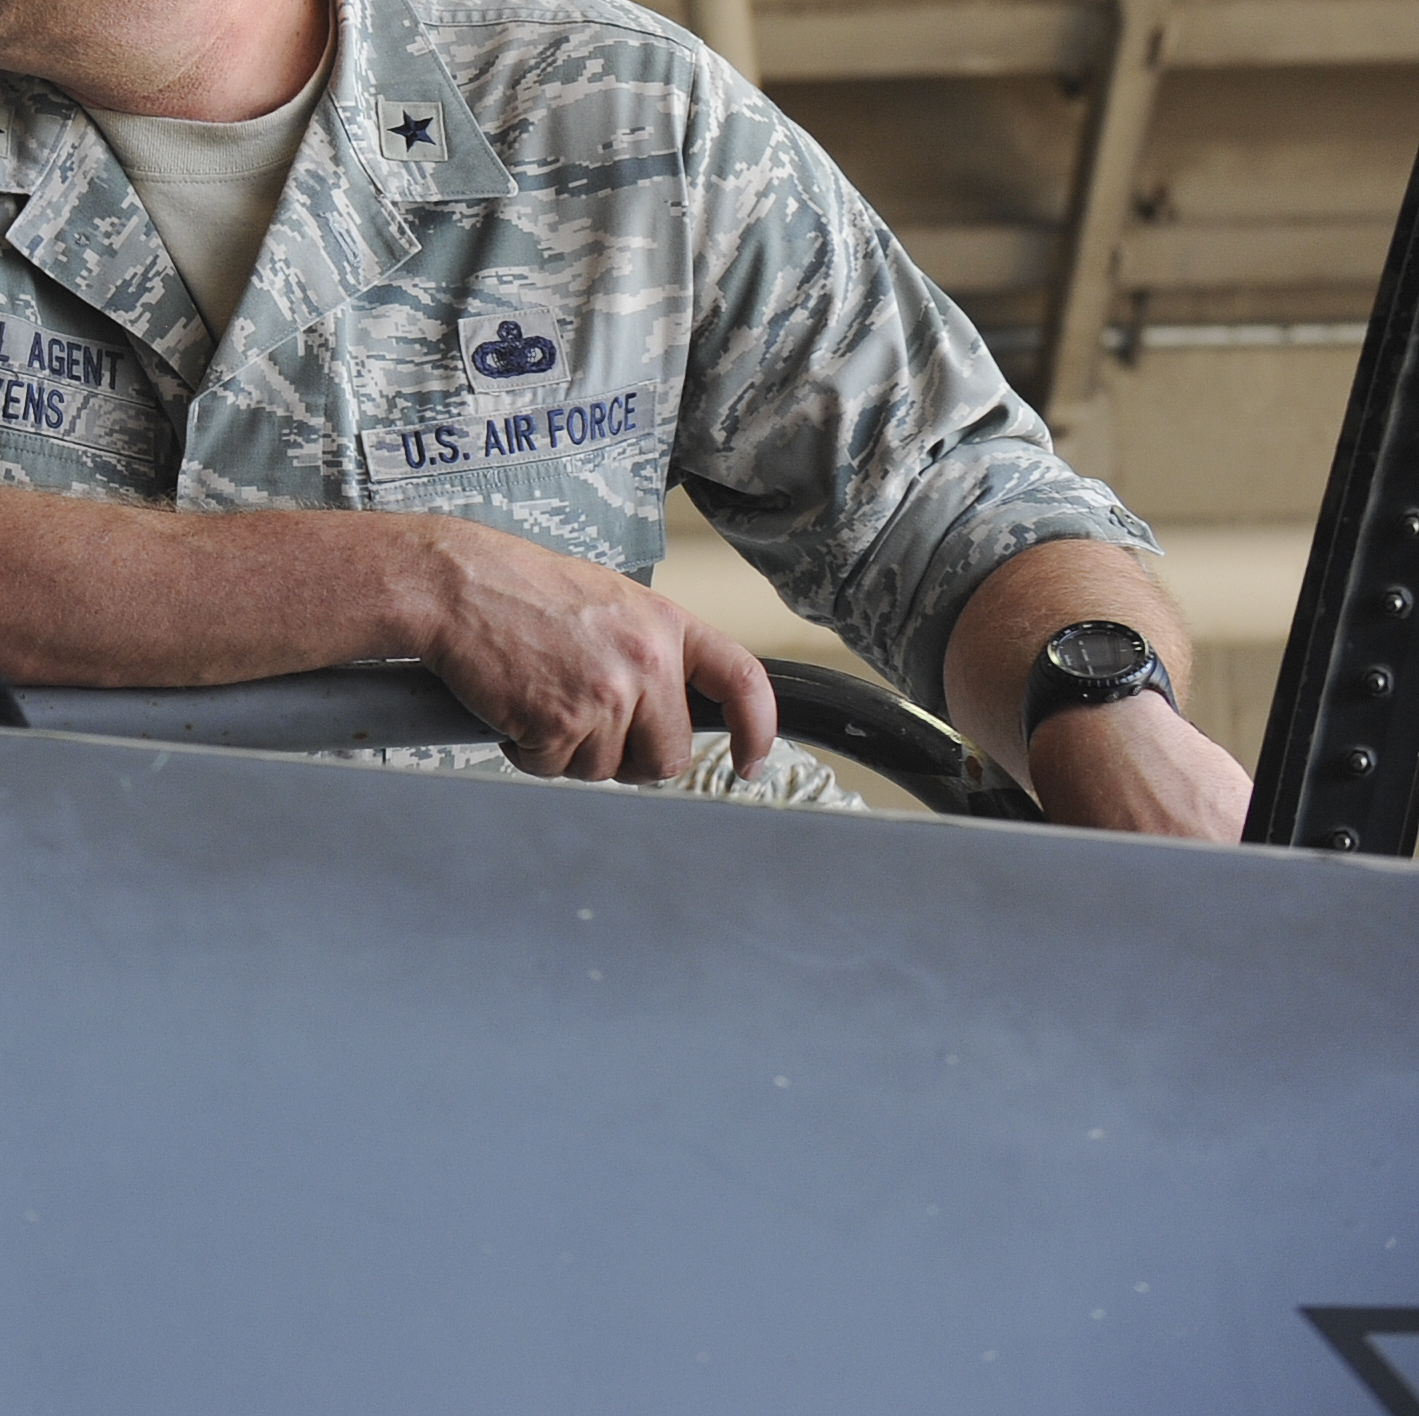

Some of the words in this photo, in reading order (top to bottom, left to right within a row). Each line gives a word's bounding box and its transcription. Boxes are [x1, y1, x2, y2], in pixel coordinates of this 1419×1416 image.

[28, 332, 125, 390] AGENT
[402, 425, 471, 469] U.S.
[485, 415, 537, 457] AIR
[547, 392, 638, 448] FORCE
